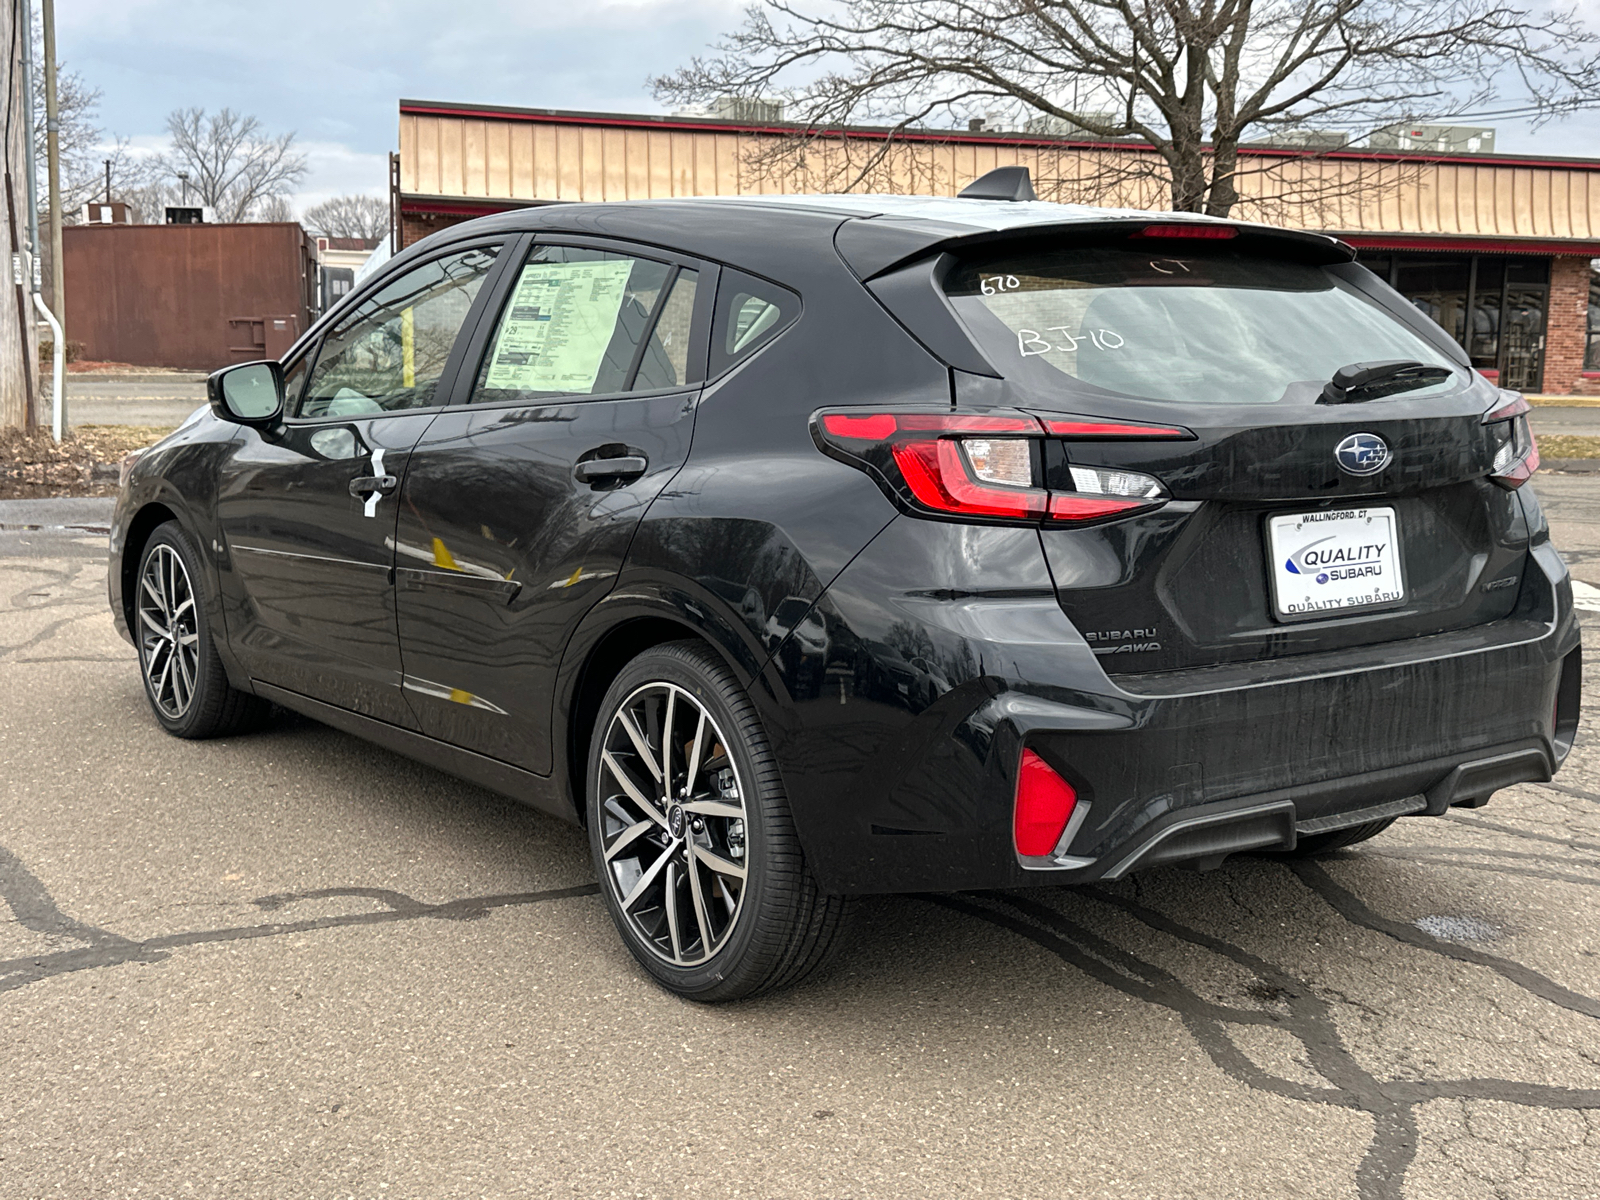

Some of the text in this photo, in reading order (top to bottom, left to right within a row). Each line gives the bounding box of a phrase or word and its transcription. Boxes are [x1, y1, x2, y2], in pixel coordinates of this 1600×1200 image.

[1150, 259, 1192, 274] CT
[980, 275, 1020, 296] 670
[1017, 326, 1124, 357] BJ-10
[1358, 510, 1367, 518] CT
[1304, 543, 1386, 566] QUALITY
[1330, 565, 1382, 581] SUBARU
[1288, 591, 1400, 613] QUALITY SUBARU
[1085, 628, 1157, 642] SUBARU
[1114, 642, 1162, 654] AWD
